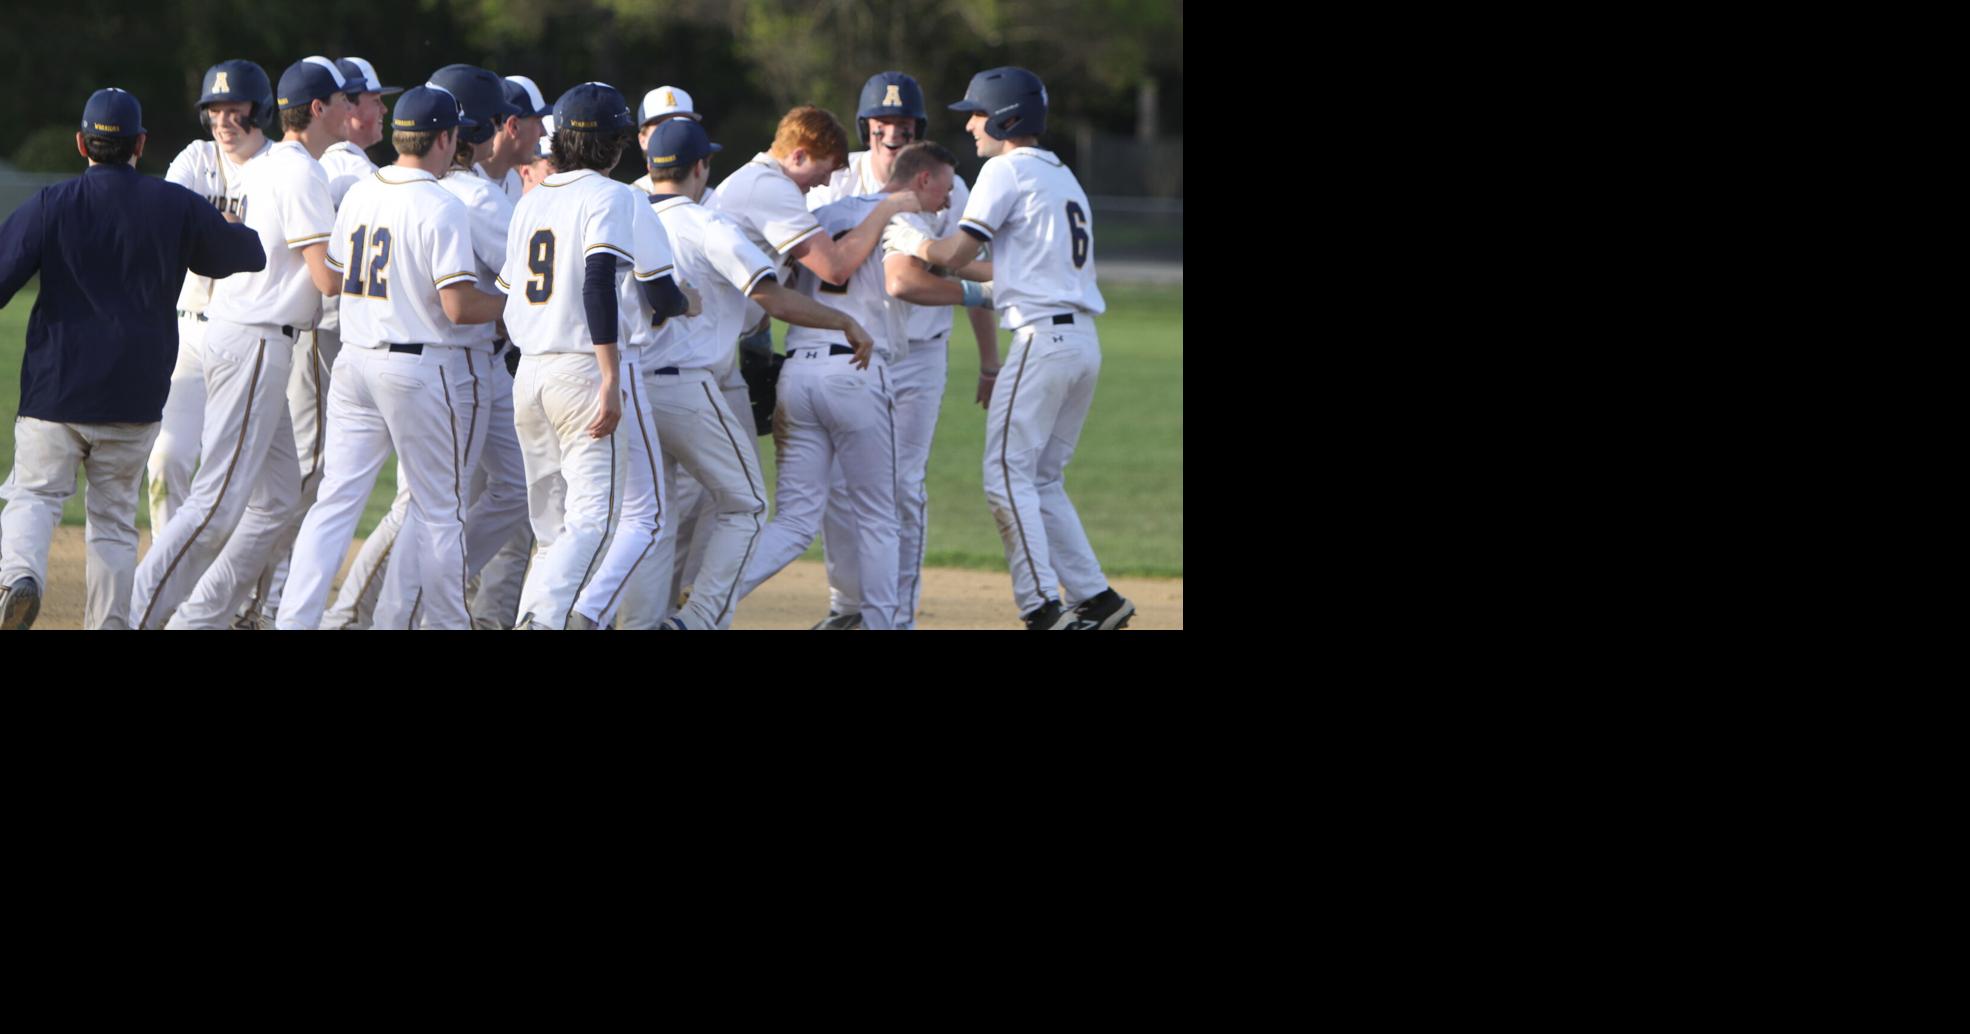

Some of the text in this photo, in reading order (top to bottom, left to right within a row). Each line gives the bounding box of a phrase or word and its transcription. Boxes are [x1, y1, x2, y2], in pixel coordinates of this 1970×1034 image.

[212, 72, 230, 94] A
[665, 91, 678, 107] A
[882, 85, 903, 107] A
[1065, 200, 1089, 271] 6
[343, 224, 392, 301] 12
[526, 226, 556, 306] 9
